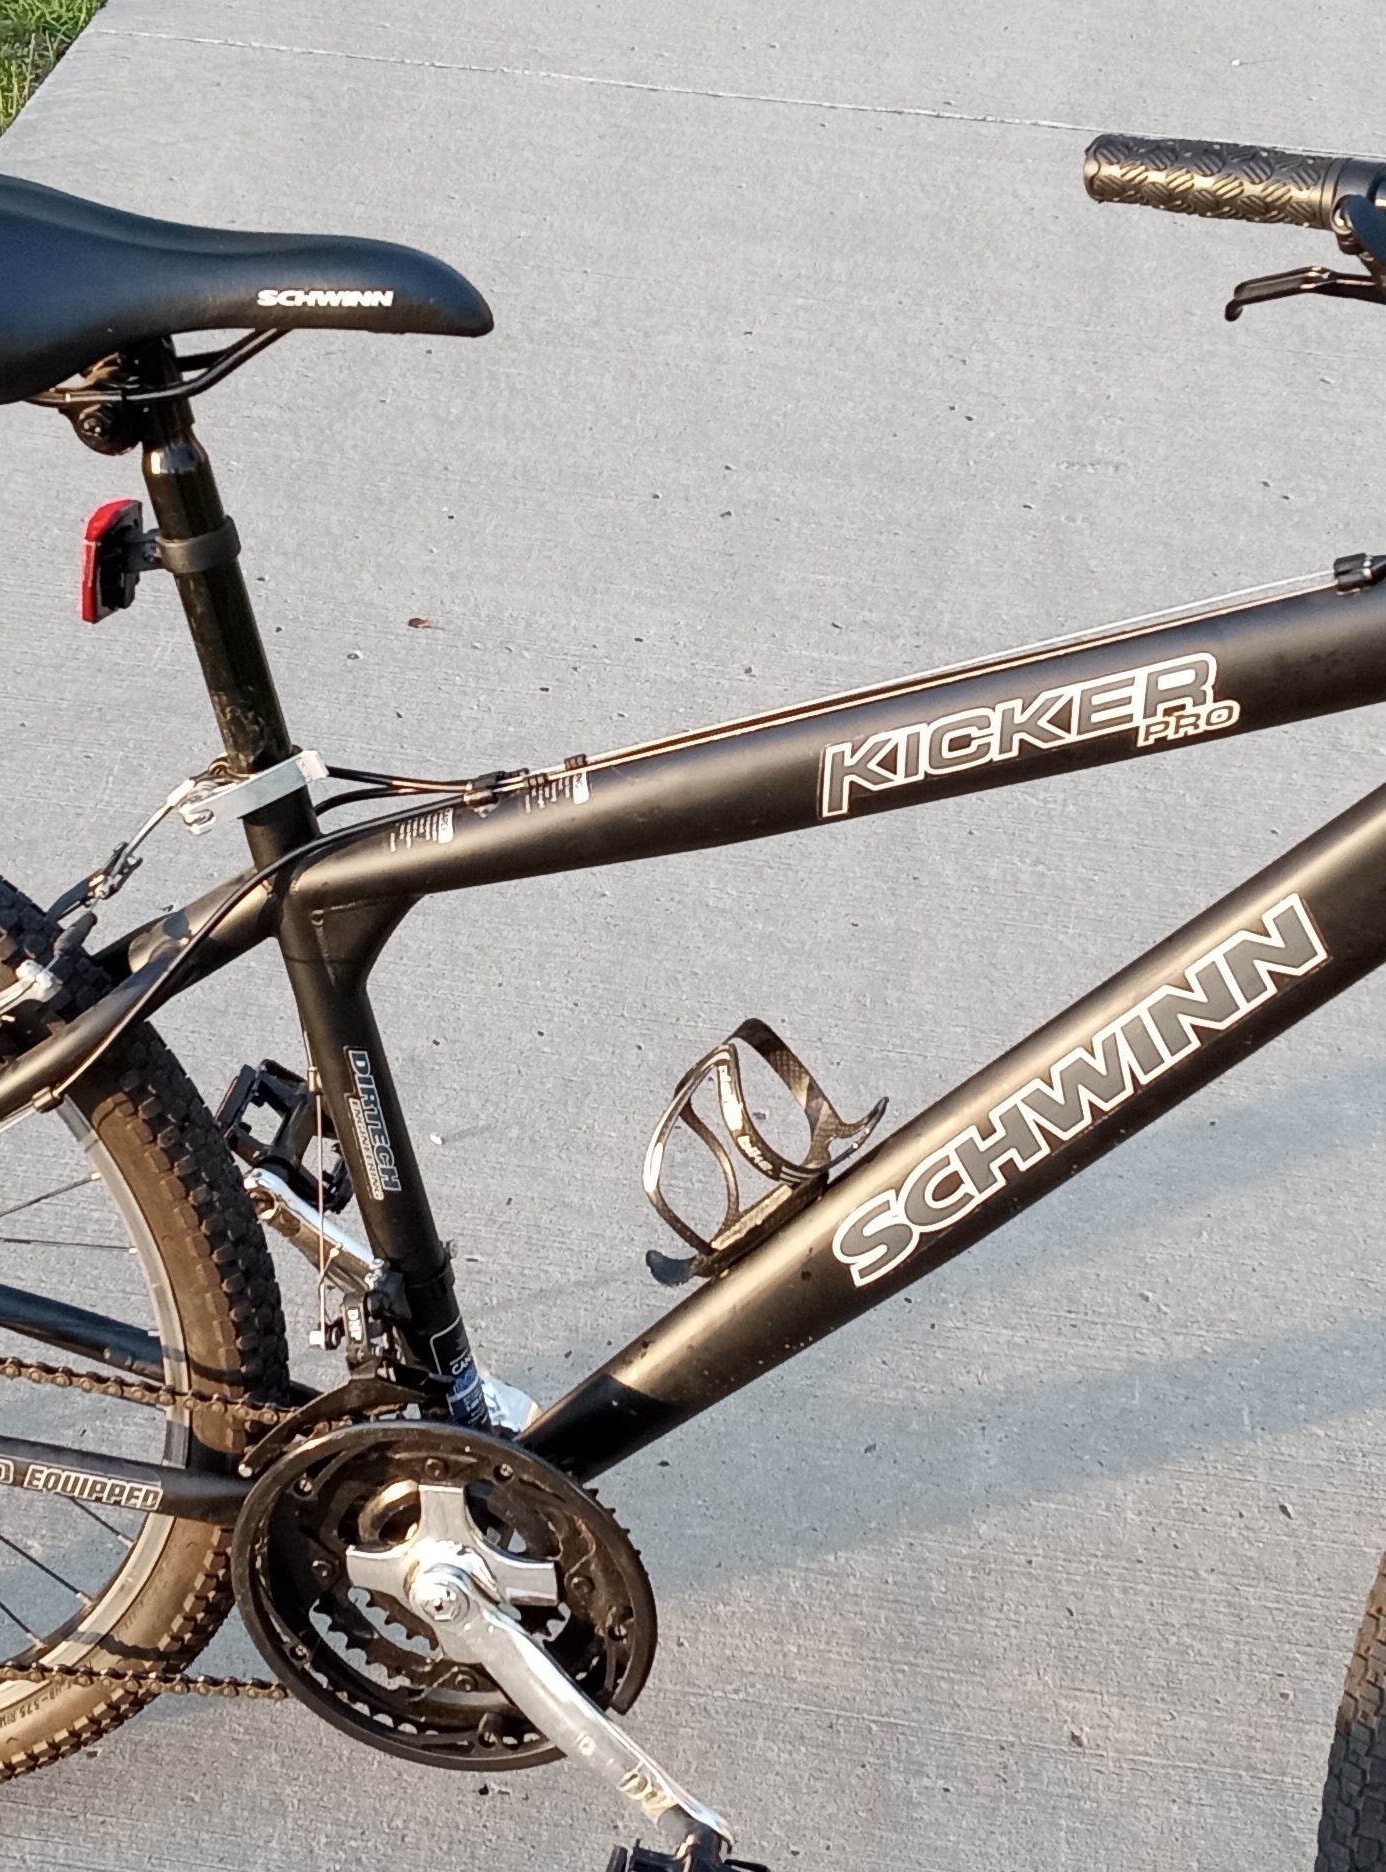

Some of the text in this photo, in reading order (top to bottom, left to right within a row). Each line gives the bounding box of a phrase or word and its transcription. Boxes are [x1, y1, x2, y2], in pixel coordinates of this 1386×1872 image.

[256, 289, 395, 308] SCHWINN
[820, 651, 1218, 818] KICKER
[1136, 700, 1240, 748] PRO
[831, 891, 1329, 1288] SCHWINN
[23, 1464, 164, 1511] EQUIPPED
